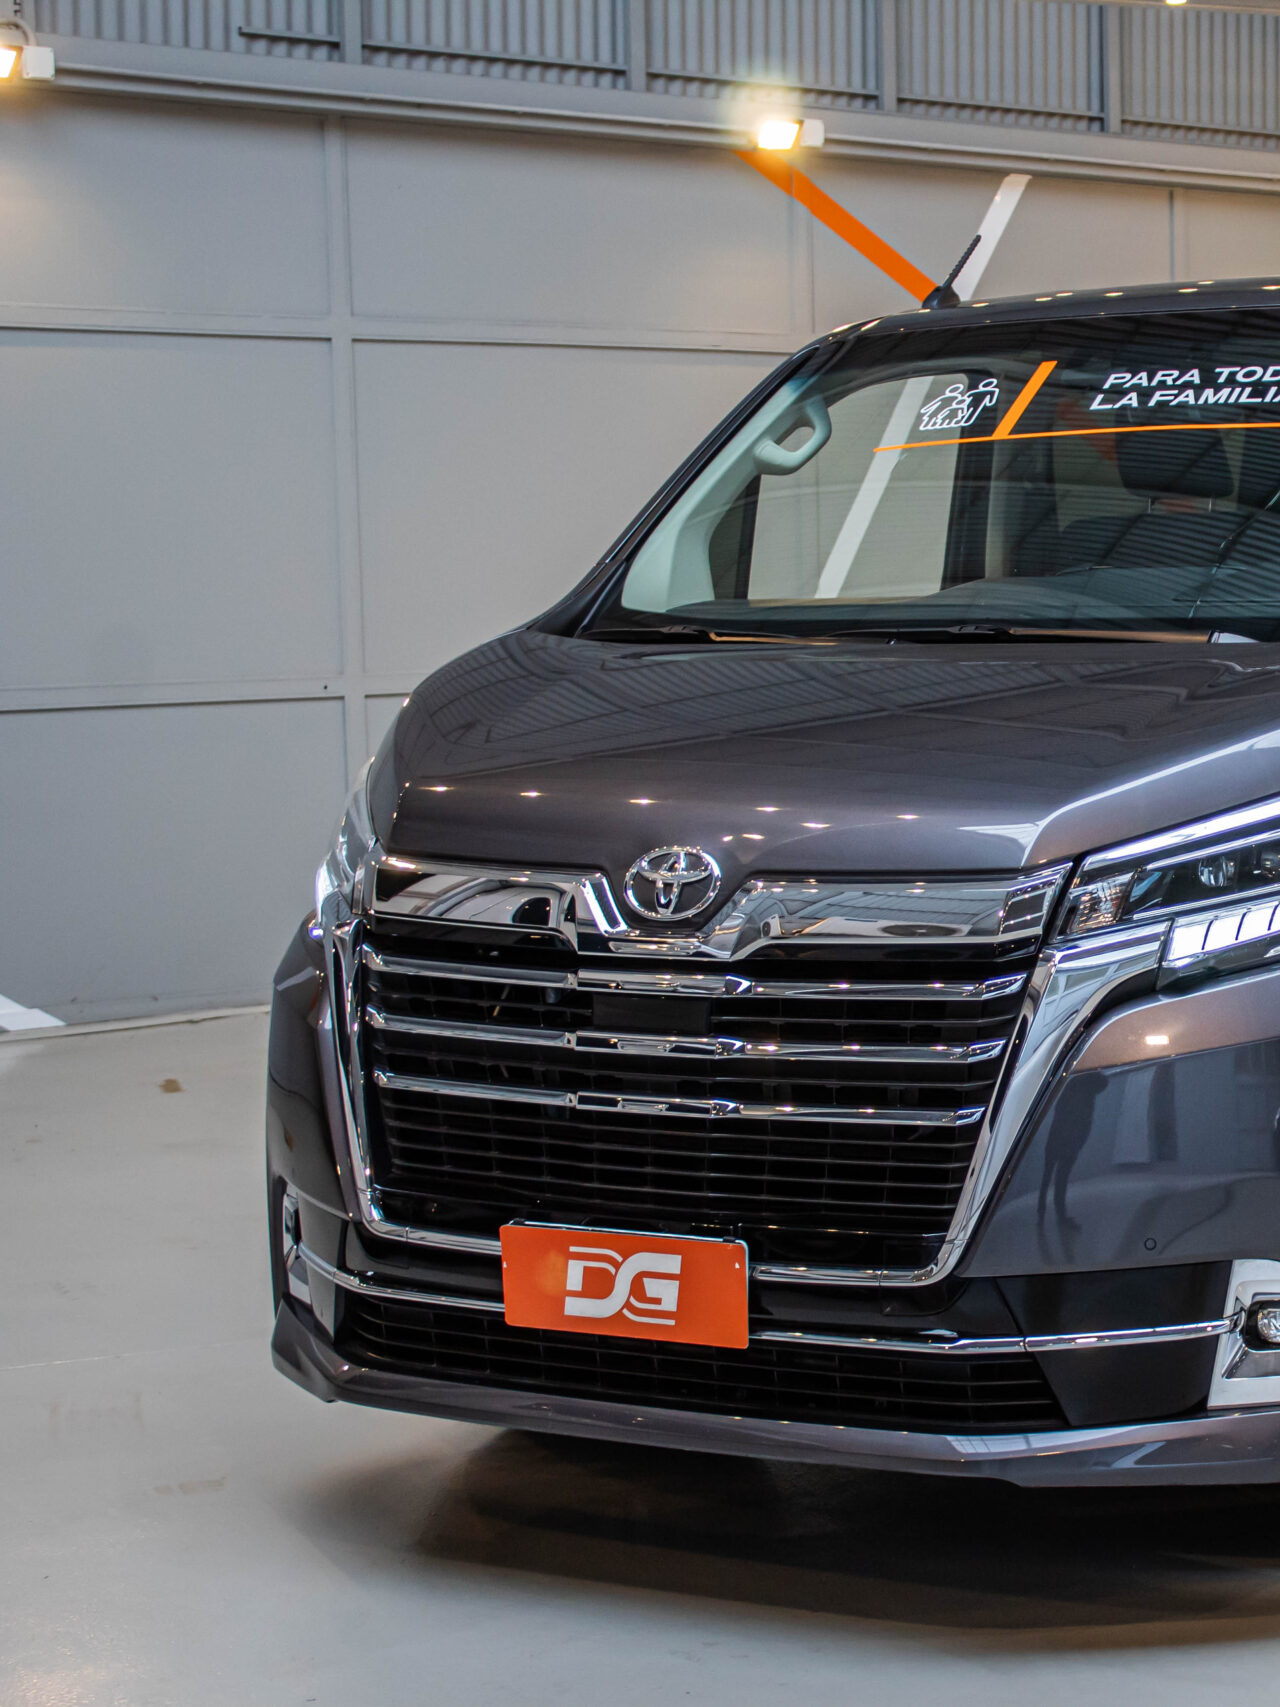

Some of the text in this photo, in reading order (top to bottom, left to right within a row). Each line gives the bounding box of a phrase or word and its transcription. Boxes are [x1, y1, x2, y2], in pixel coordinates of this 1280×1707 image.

[1101, 368, 1201, 390] PARA
[1089, 391, 1139, 411] LA
[563, 1245, 682, 1326] DG
